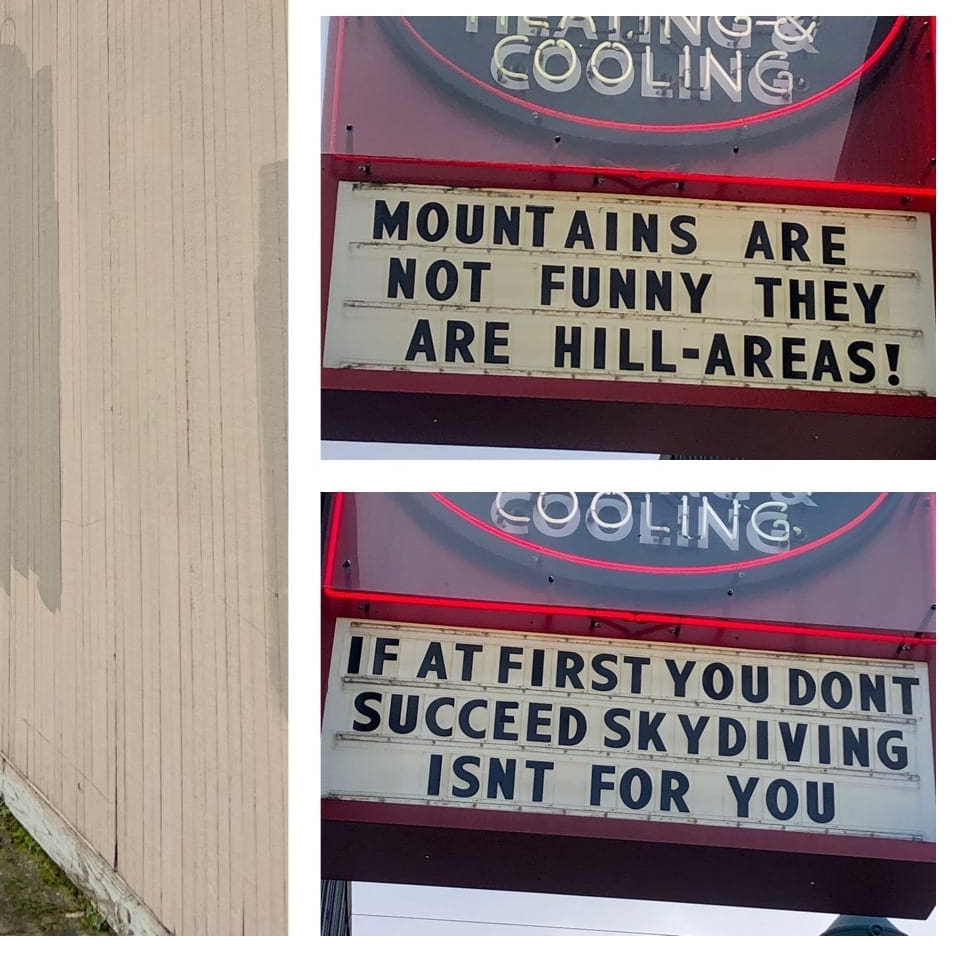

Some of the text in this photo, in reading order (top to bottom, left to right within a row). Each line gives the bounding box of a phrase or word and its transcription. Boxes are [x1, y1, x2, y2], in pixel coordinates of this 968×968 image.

[490, 35, 794, 105] COOLING
[372, 200, 846, 265] MOUNTAINS ARE
[387, 257, 884, 324] NOT FUNNY THEY
[405, 319, 900, 386] ARE HILL-AREAS!
[490, 492, 791, 554] COOLING
[347, 636, 919, 715] IF AT FIRST YOU DONT
[352, 692, 908, 771] SUCCEED SKYDIVING
[427, 754, 835, 824] ISNT FOR YOU
